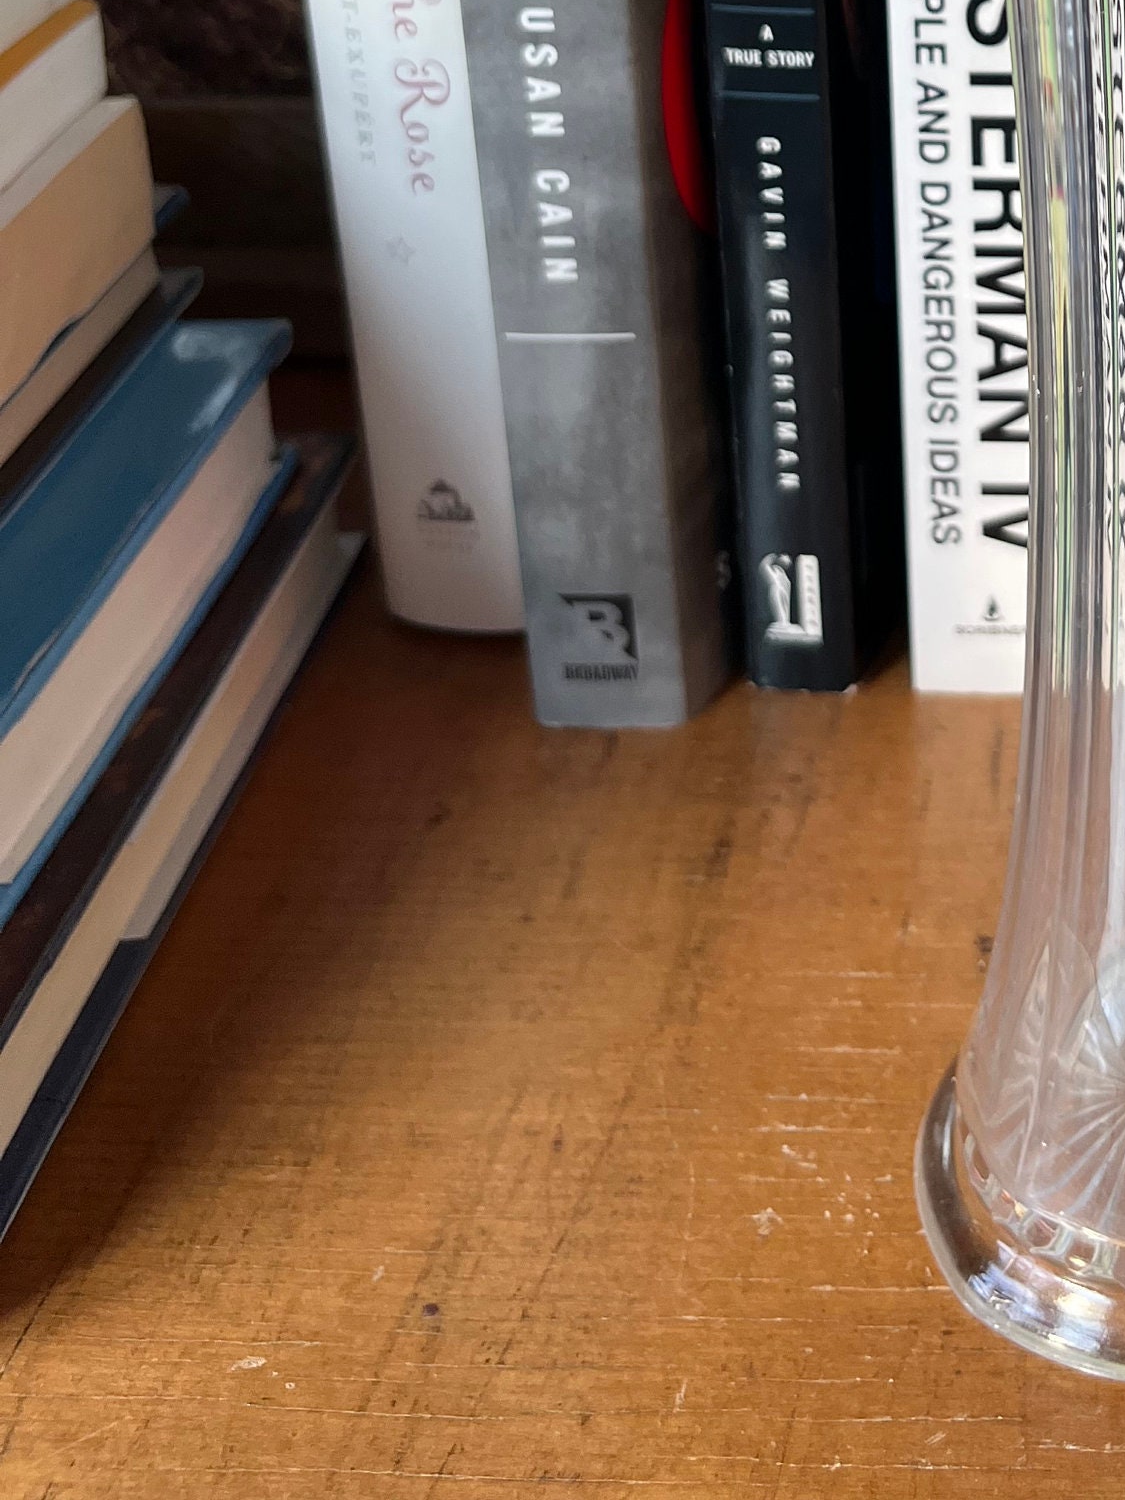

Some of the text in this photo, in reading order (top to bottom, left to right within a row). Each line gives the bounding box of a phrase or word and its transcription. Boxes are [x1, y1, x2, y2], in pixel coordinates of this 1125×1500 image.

[724, 47, 816, 68] TRUE STORY
[757, 23, 774, 42] A
[395, 58, 451, 196] Rose
[915, 79, 951, 165] AND
[535, 169, 580, 284] CAIN
[756, 136, 801, 490] GAVIN WEIGHTMAN
[919, 180, 958, 424] DANGEROUS
[927, 438, 962, 545] IDEAS
